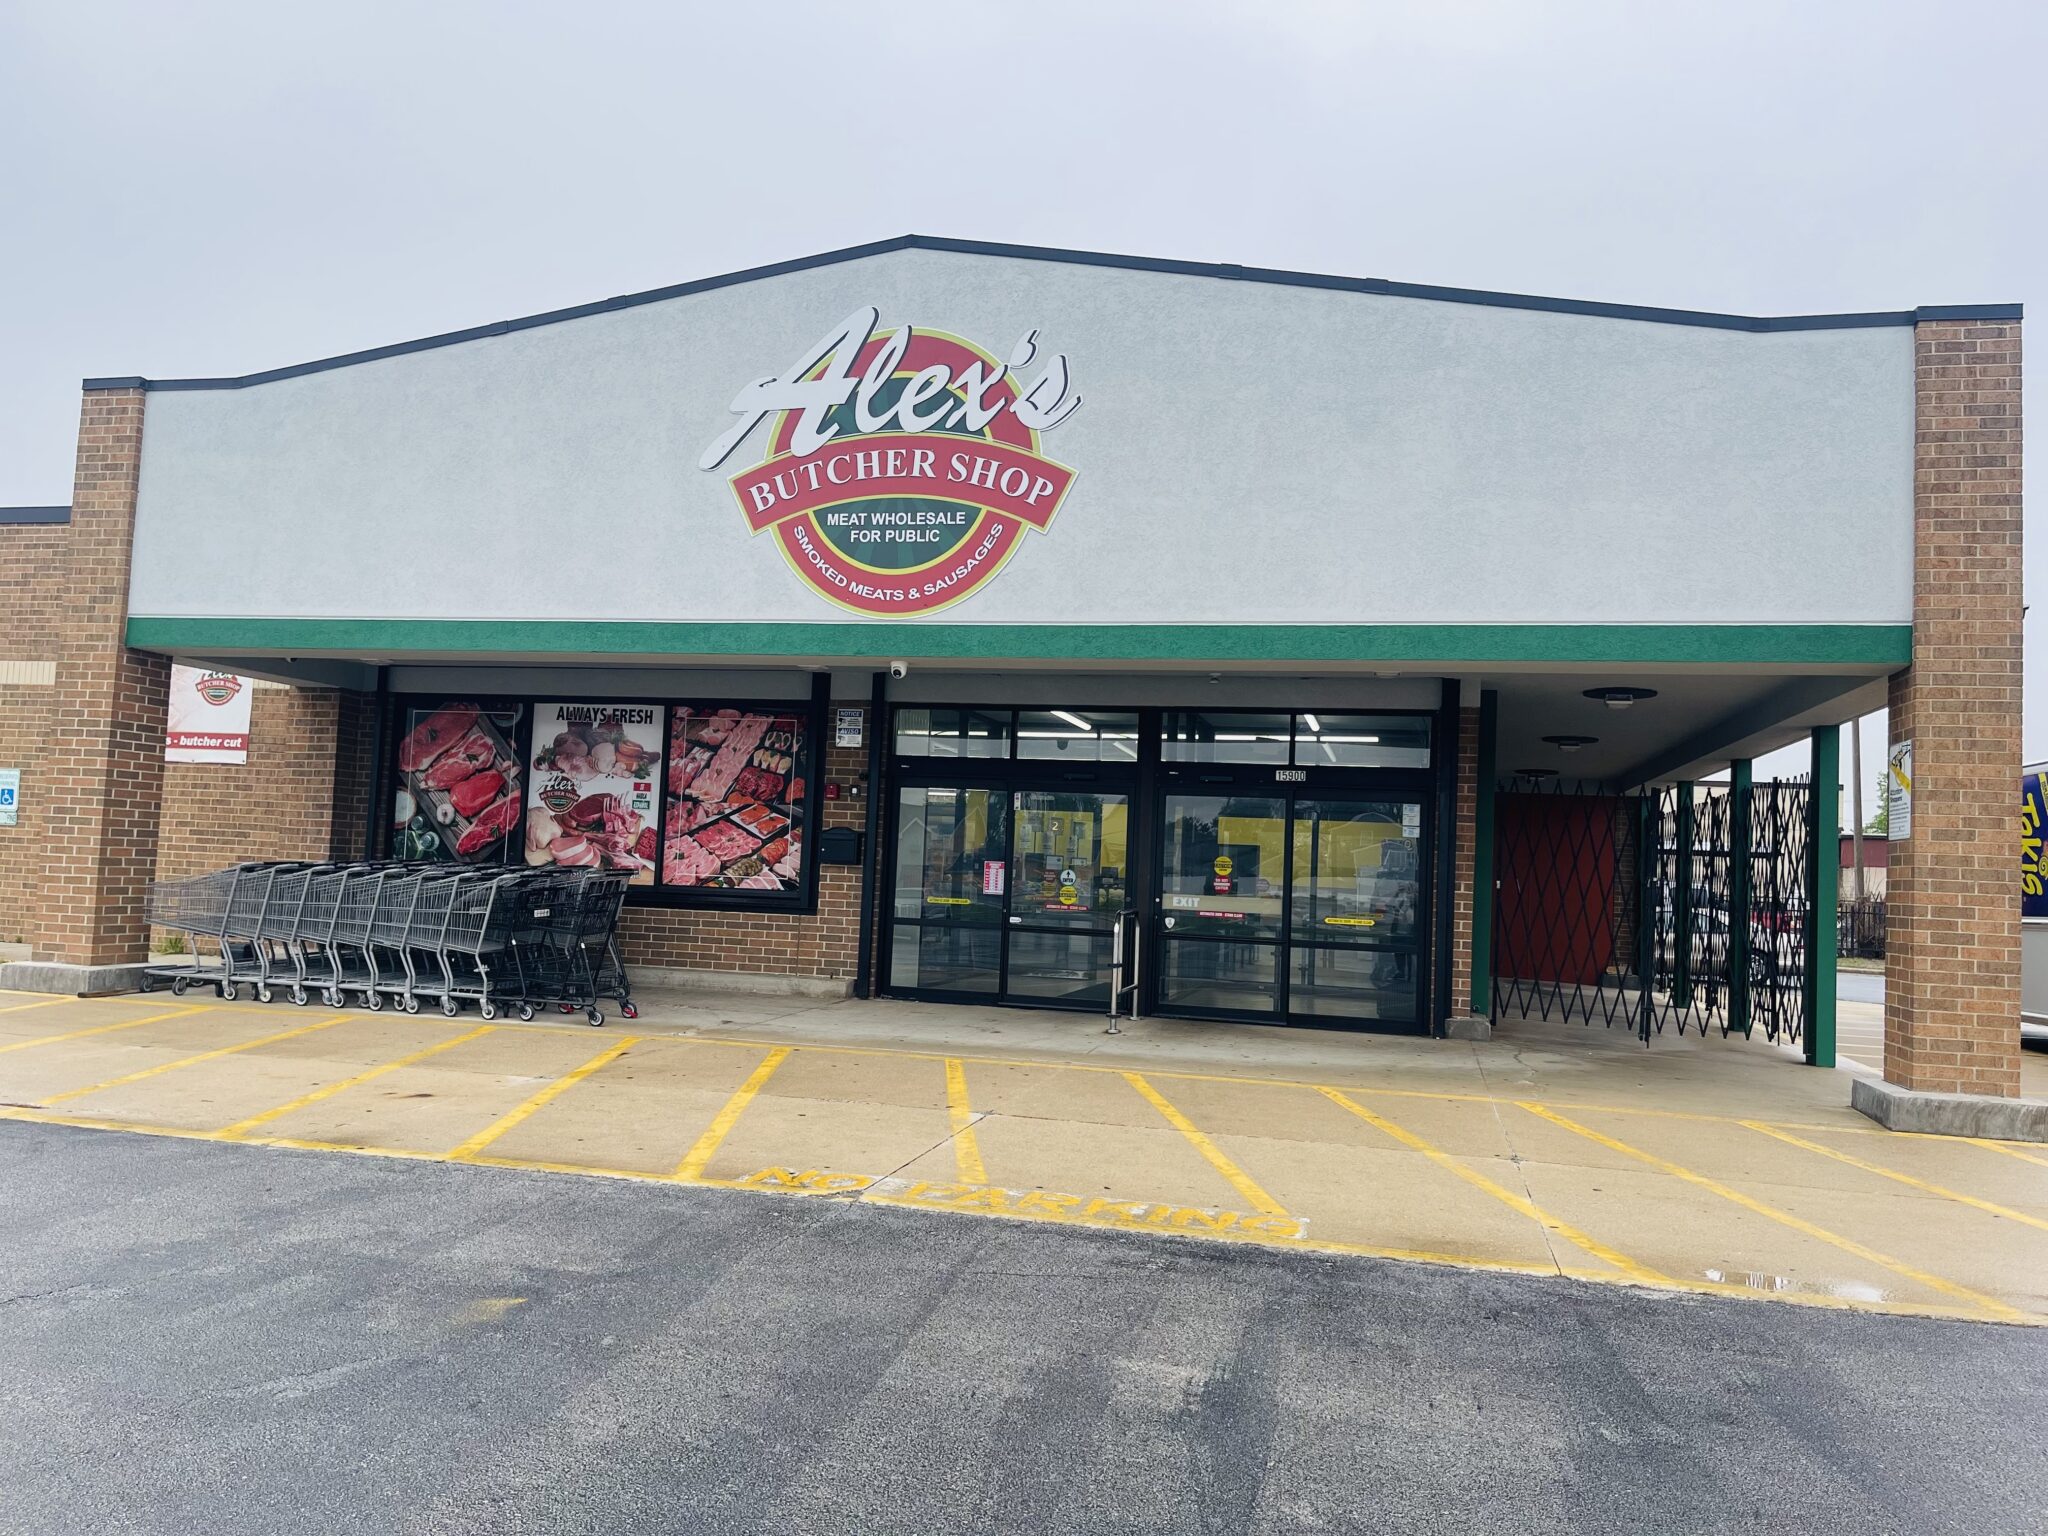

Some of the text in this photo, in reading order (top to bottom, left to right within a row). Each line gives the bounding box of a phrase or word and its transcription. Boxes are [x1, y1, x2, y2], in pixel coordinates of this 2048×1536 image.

[700, 305, 1084, 472] Alex's
[747, 449, 1055, 514] BUTCHER SHOP
[827, 512, 966, 526] MEAT WHOLESALE
[850, 529, 940, 543] FOR PUBLIC
[794, 522, 1003, 601] SMOKED MEATS & SAUSAGES
[197, 680, 225, 690] BUTCHER
[556, 706, 654, 724] ALWAYS FRESH
[180, 735, 222, 747] butcher
[224, 737, 242, 747] cut
[1278, 771, 1305, 781] 15900
[1051, 821, 1059, 831] 2
[2021, 792, 2043, 896] Takis
[1172, 896, 1200, 908] EXIT
[747, 1166, 1302, 1236] NO PARKING
